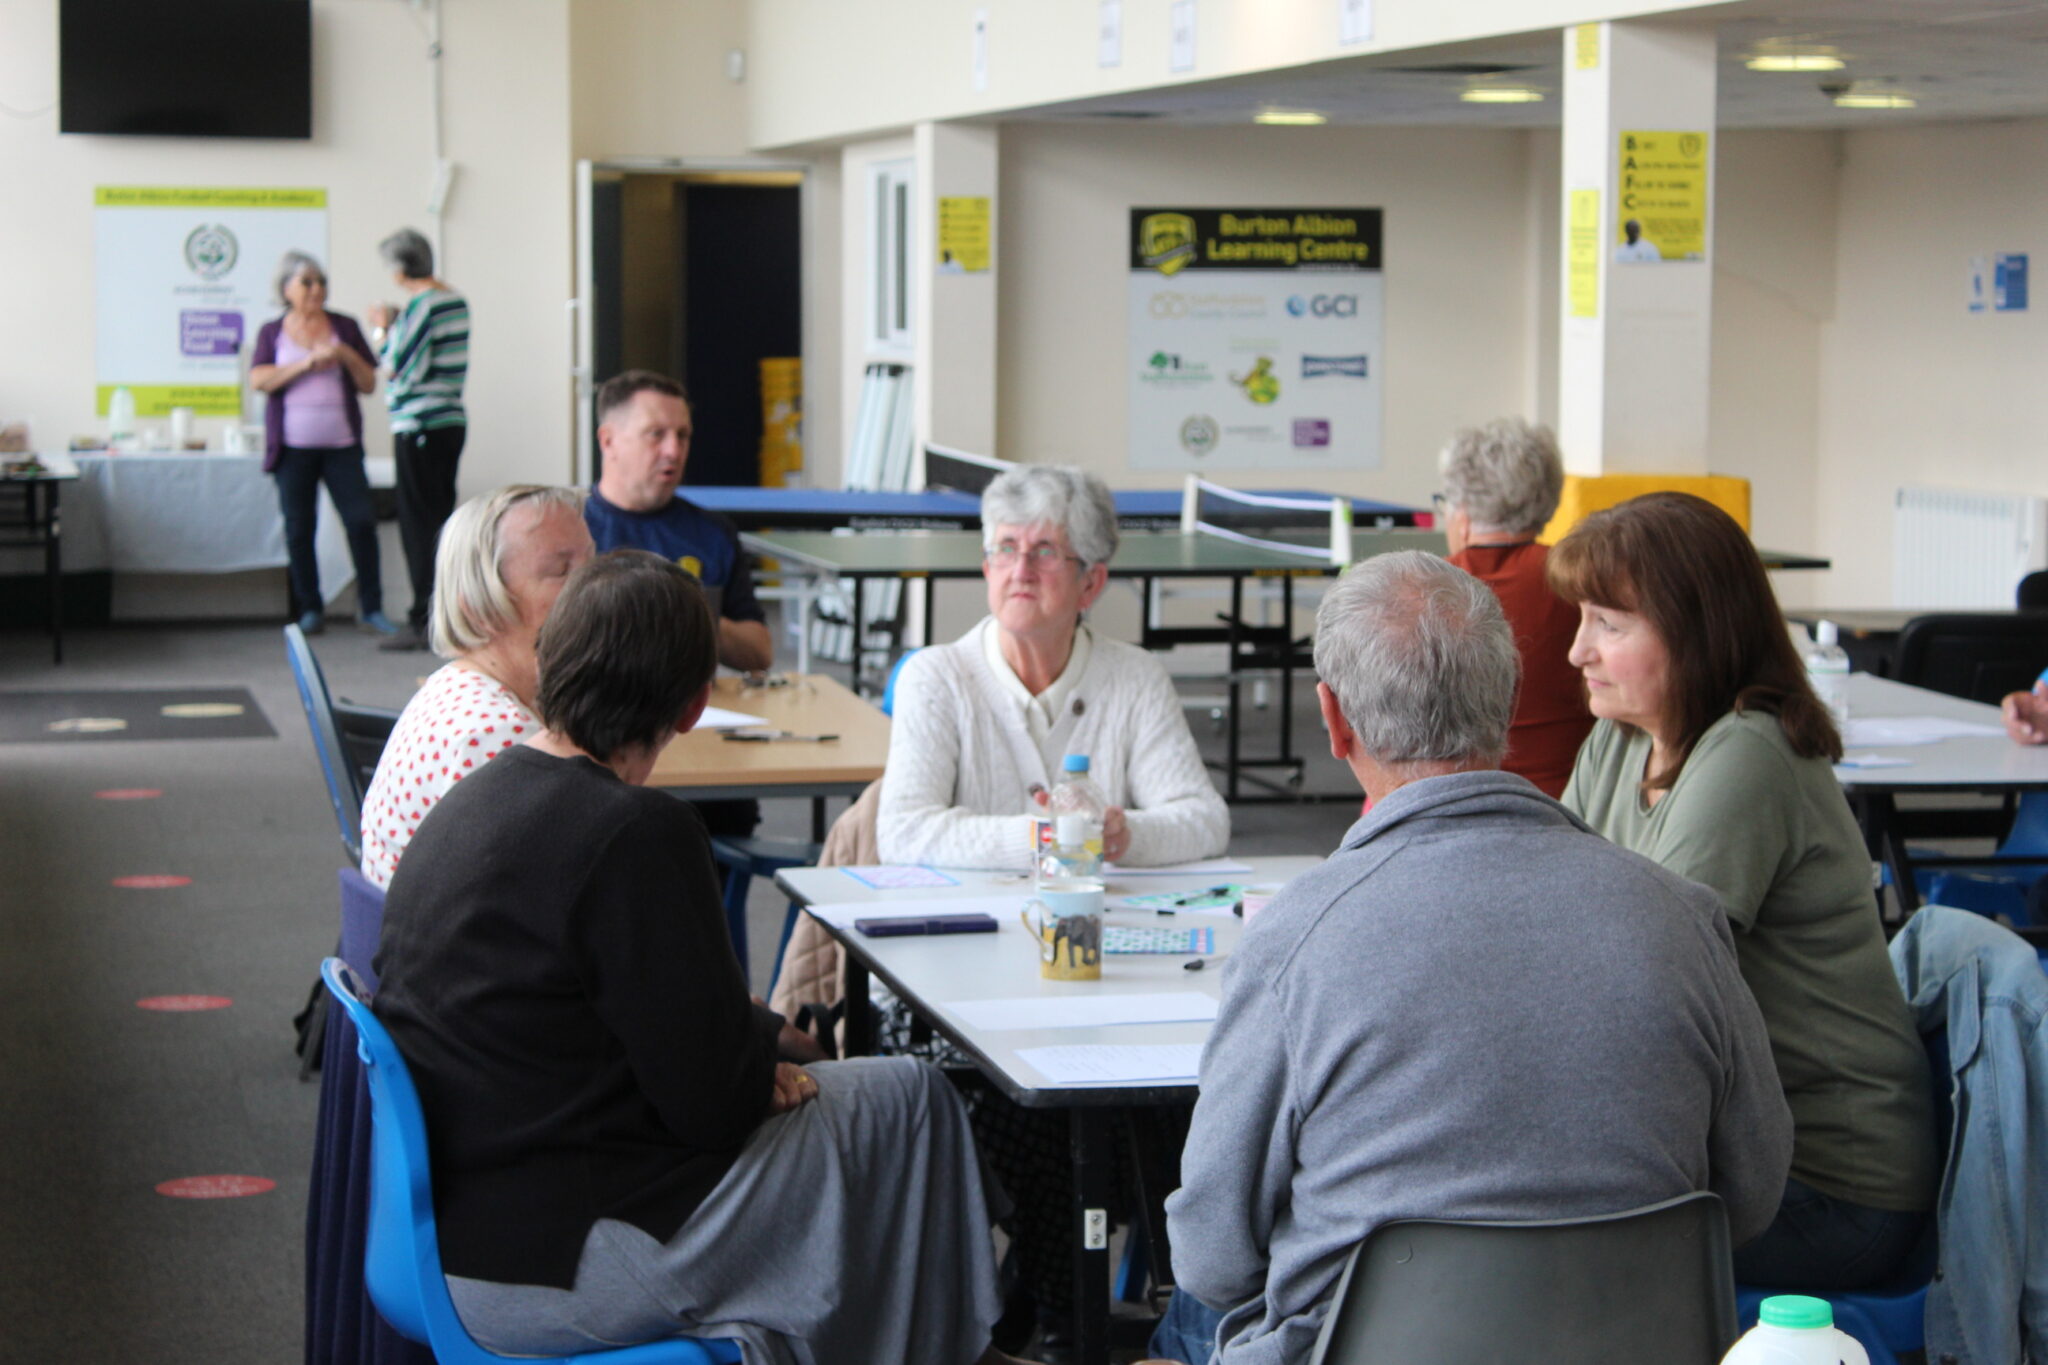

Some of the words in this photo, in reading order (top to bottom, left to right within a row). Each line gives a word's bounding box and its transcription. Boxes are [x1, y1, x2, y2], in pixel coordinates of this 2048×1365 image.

[1218, 213, 1291, 236] Burton
[1293, 214, 1357, 236] Albion
[1207, 237, 1298, 265] Learning
[1300, 238, 1369, 261] Centre
[1310, 294, 1358, 318] GCI
